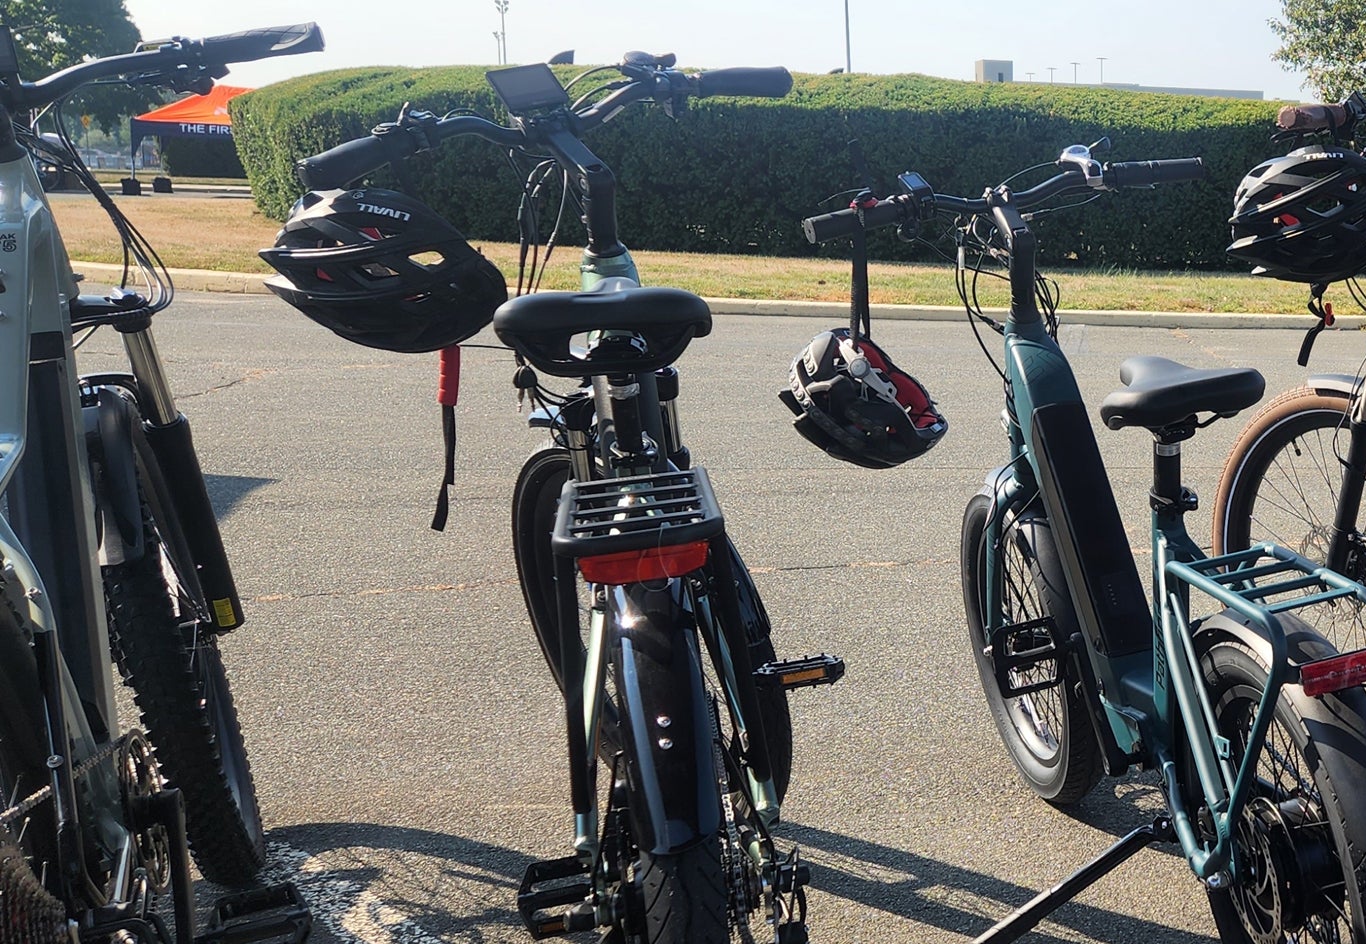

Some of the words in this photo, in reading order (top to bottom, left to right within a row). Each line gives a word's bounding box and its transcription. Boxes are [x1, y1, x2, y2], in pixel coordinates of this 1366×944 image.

[179, 123, 205, 134] THE
[1303, 152, 1344, 160] LIVALL
[357, 202, 411, 221] LIVALL
